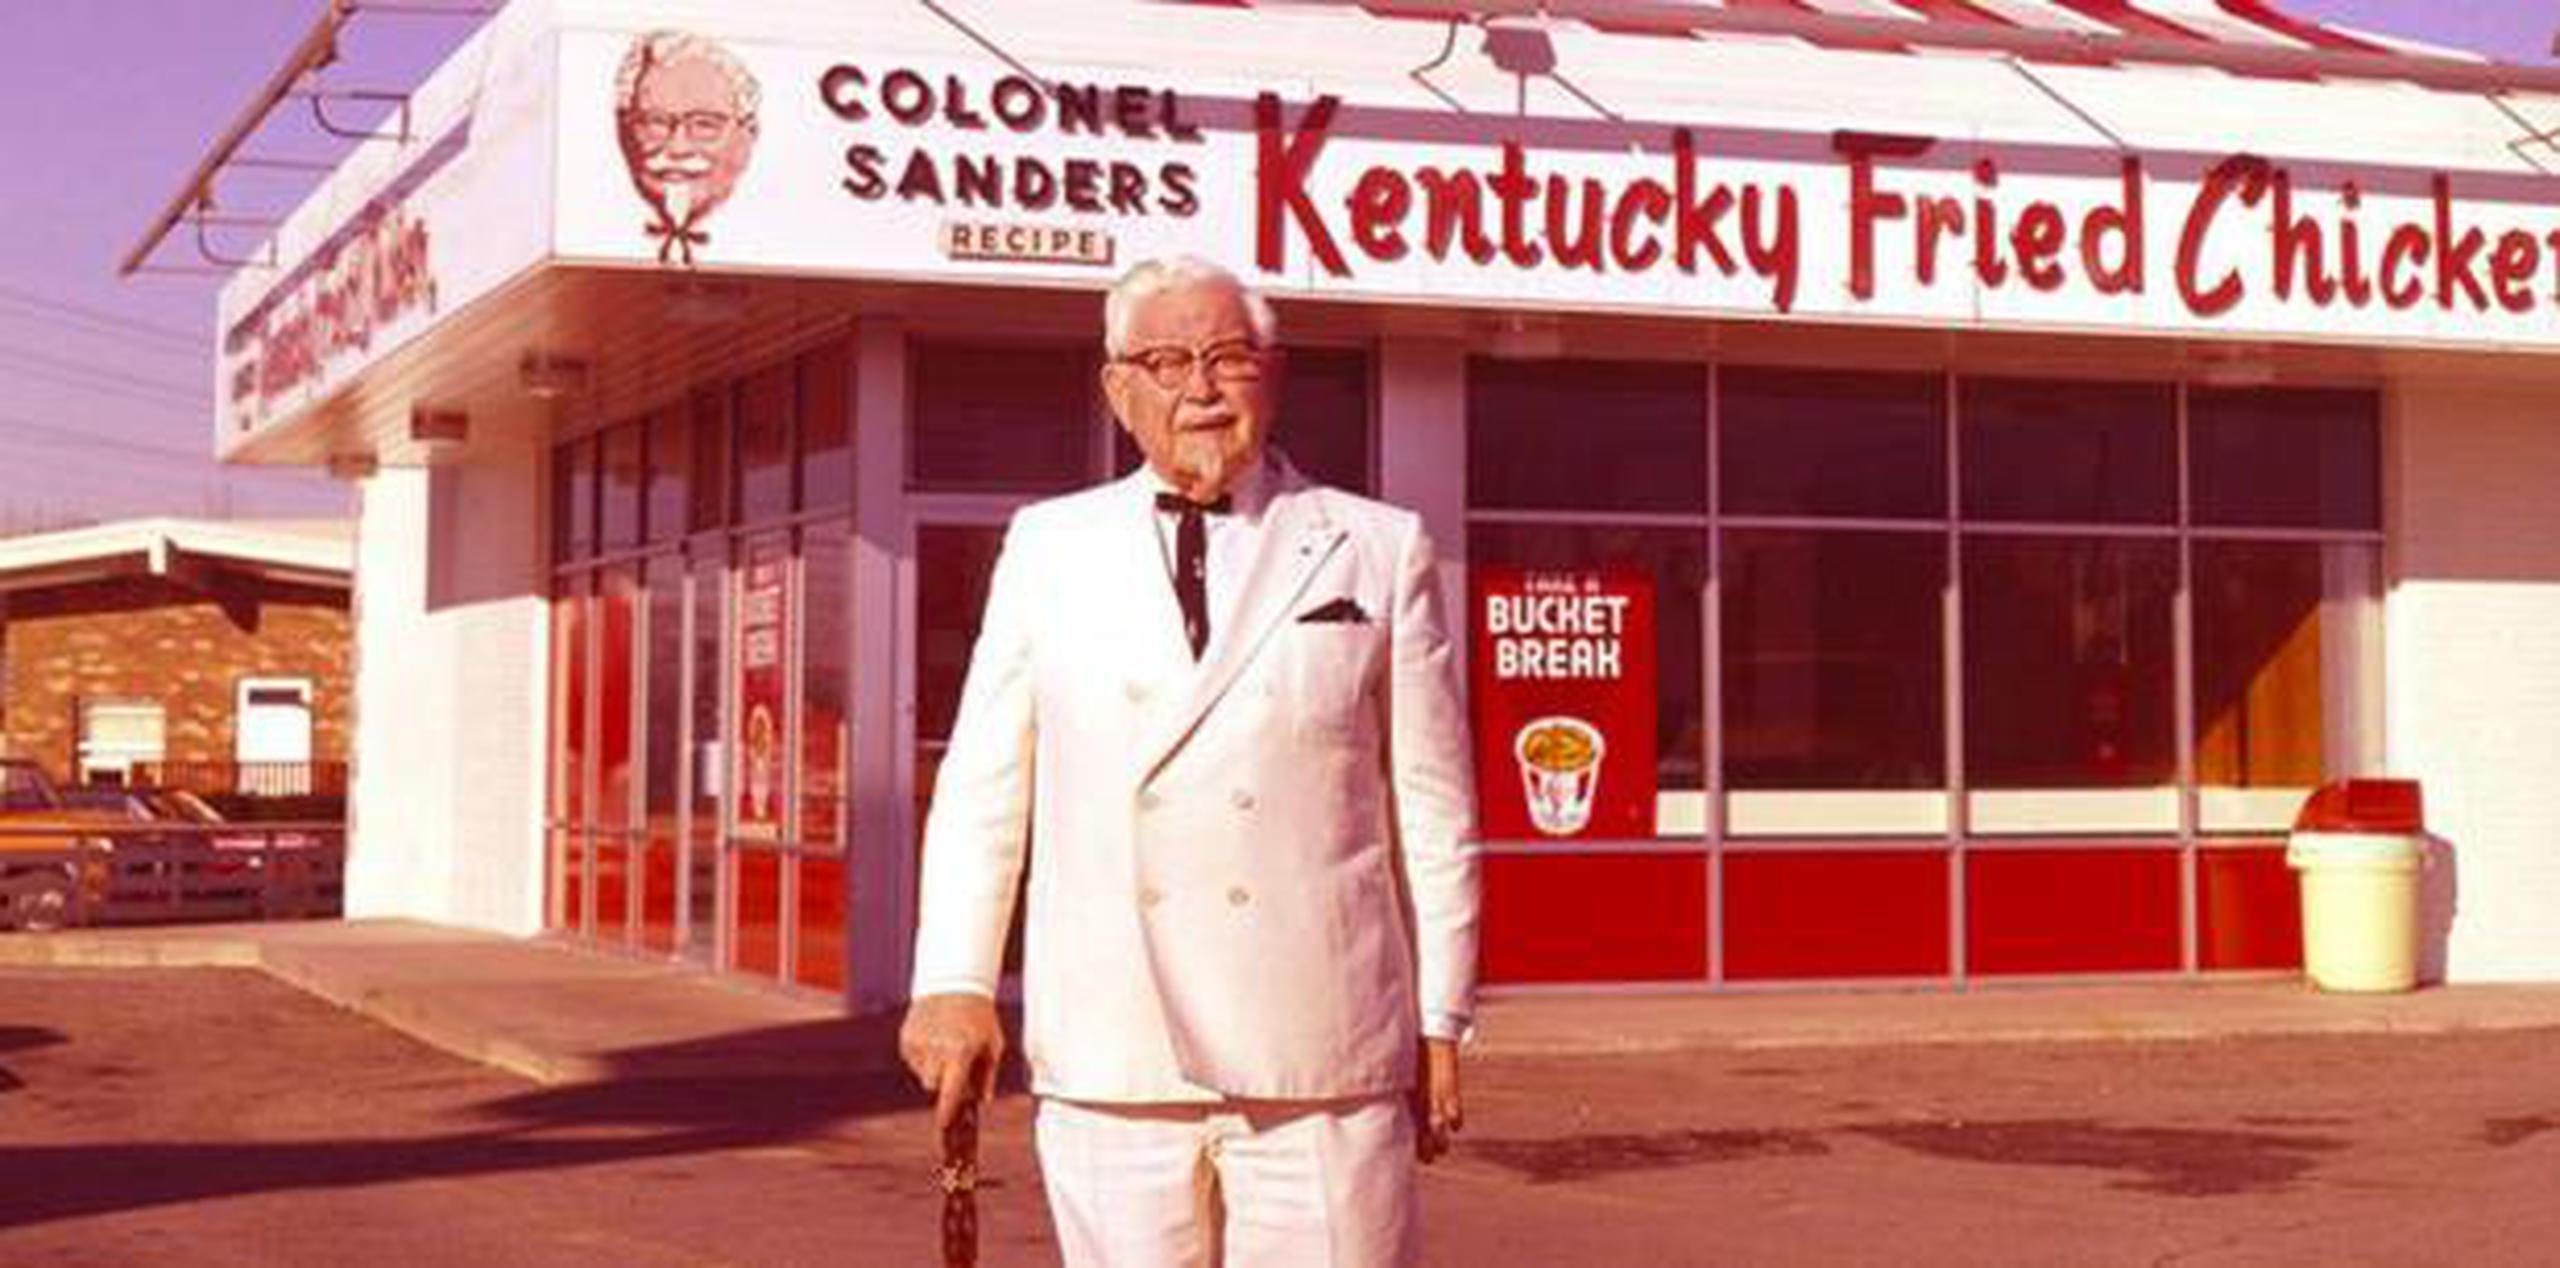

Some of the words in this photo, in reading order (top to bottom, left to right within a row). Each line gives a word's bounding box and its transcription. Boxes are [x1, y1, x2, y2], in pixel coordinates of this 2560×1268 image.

[819, 64, 1205, 143] COLONEL
[842, 144, 1201, 217] SANDERS
[1254, 92, 1799, 313] Kentucky
[1833, 130, 2144, 300] Fried
[951, 224, 1095, 255] RECIPE
[1486, 596, 1630, 635] BUCKET
[1496, 638, 1622, 679] BREAK
